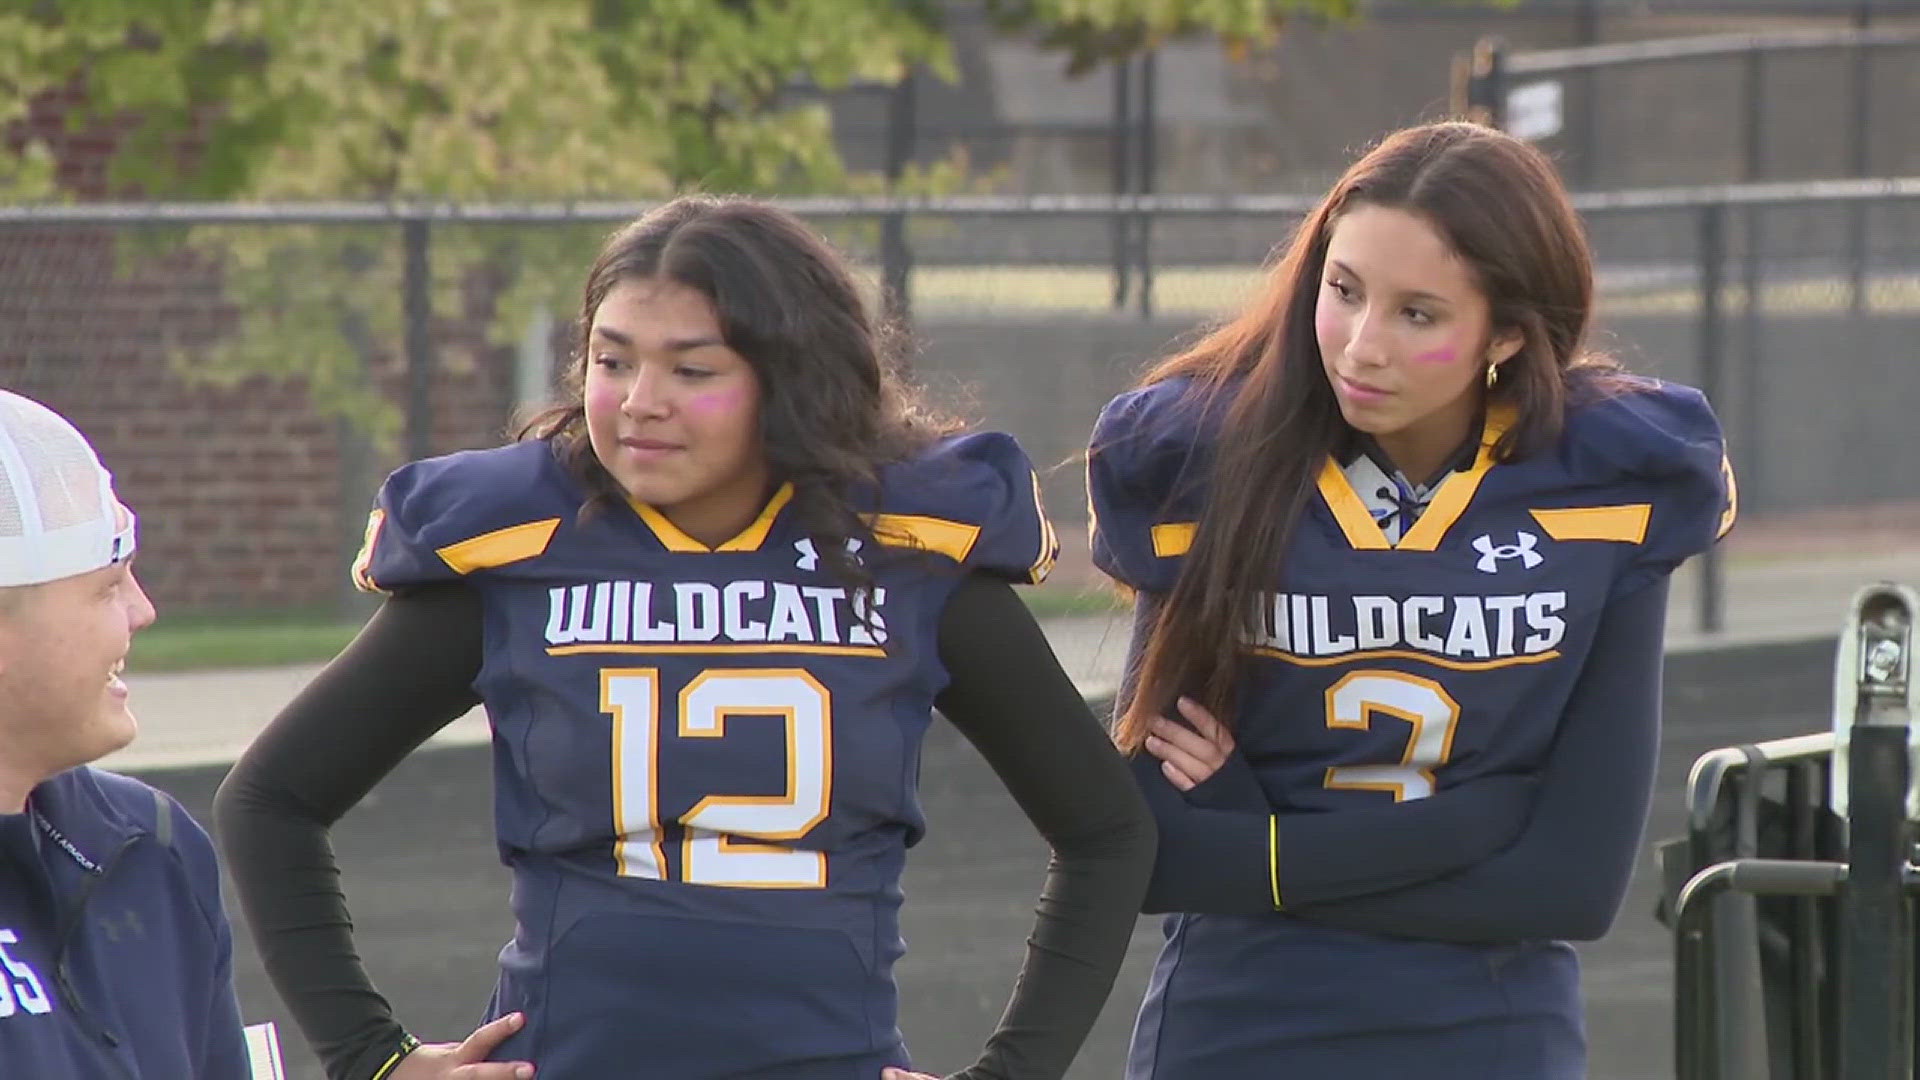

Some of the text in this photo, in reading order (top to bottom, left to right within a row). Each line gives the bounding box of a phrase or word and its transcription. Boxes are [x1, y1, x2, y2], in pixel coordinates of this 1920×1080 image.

[544, 580, 888, 645] WILDCATS
[599, 667, 832, 889] 12
[1323, 669, 1462, 803] 3
